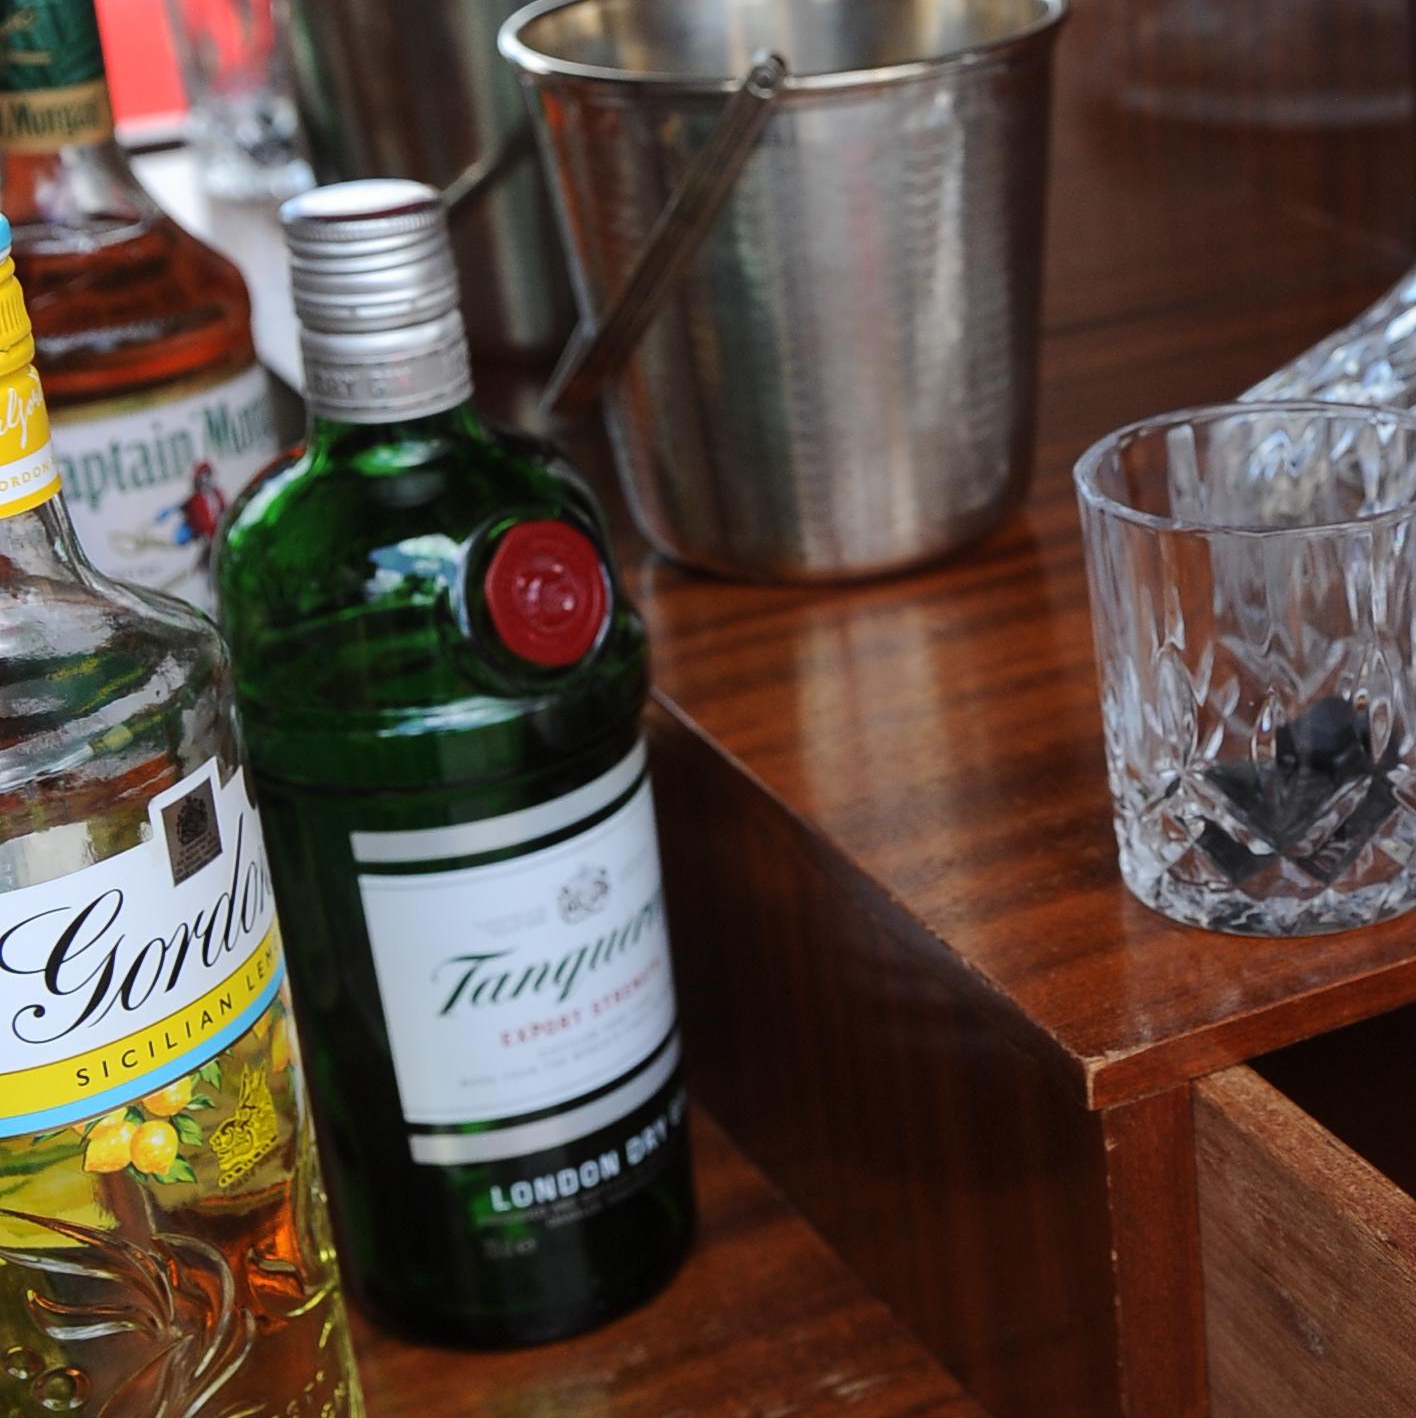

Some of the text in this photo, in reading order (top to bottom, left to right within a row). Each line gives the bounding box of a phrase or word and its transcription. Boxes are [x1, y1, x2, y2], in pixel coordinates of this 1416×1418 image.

[60, 421, 193, 513] aptain
[75, 992, 233, 1087] SICILIAN
[489, 1149, 621, 1213] LONDON
[624, 1113, 668, 1166] DRY
